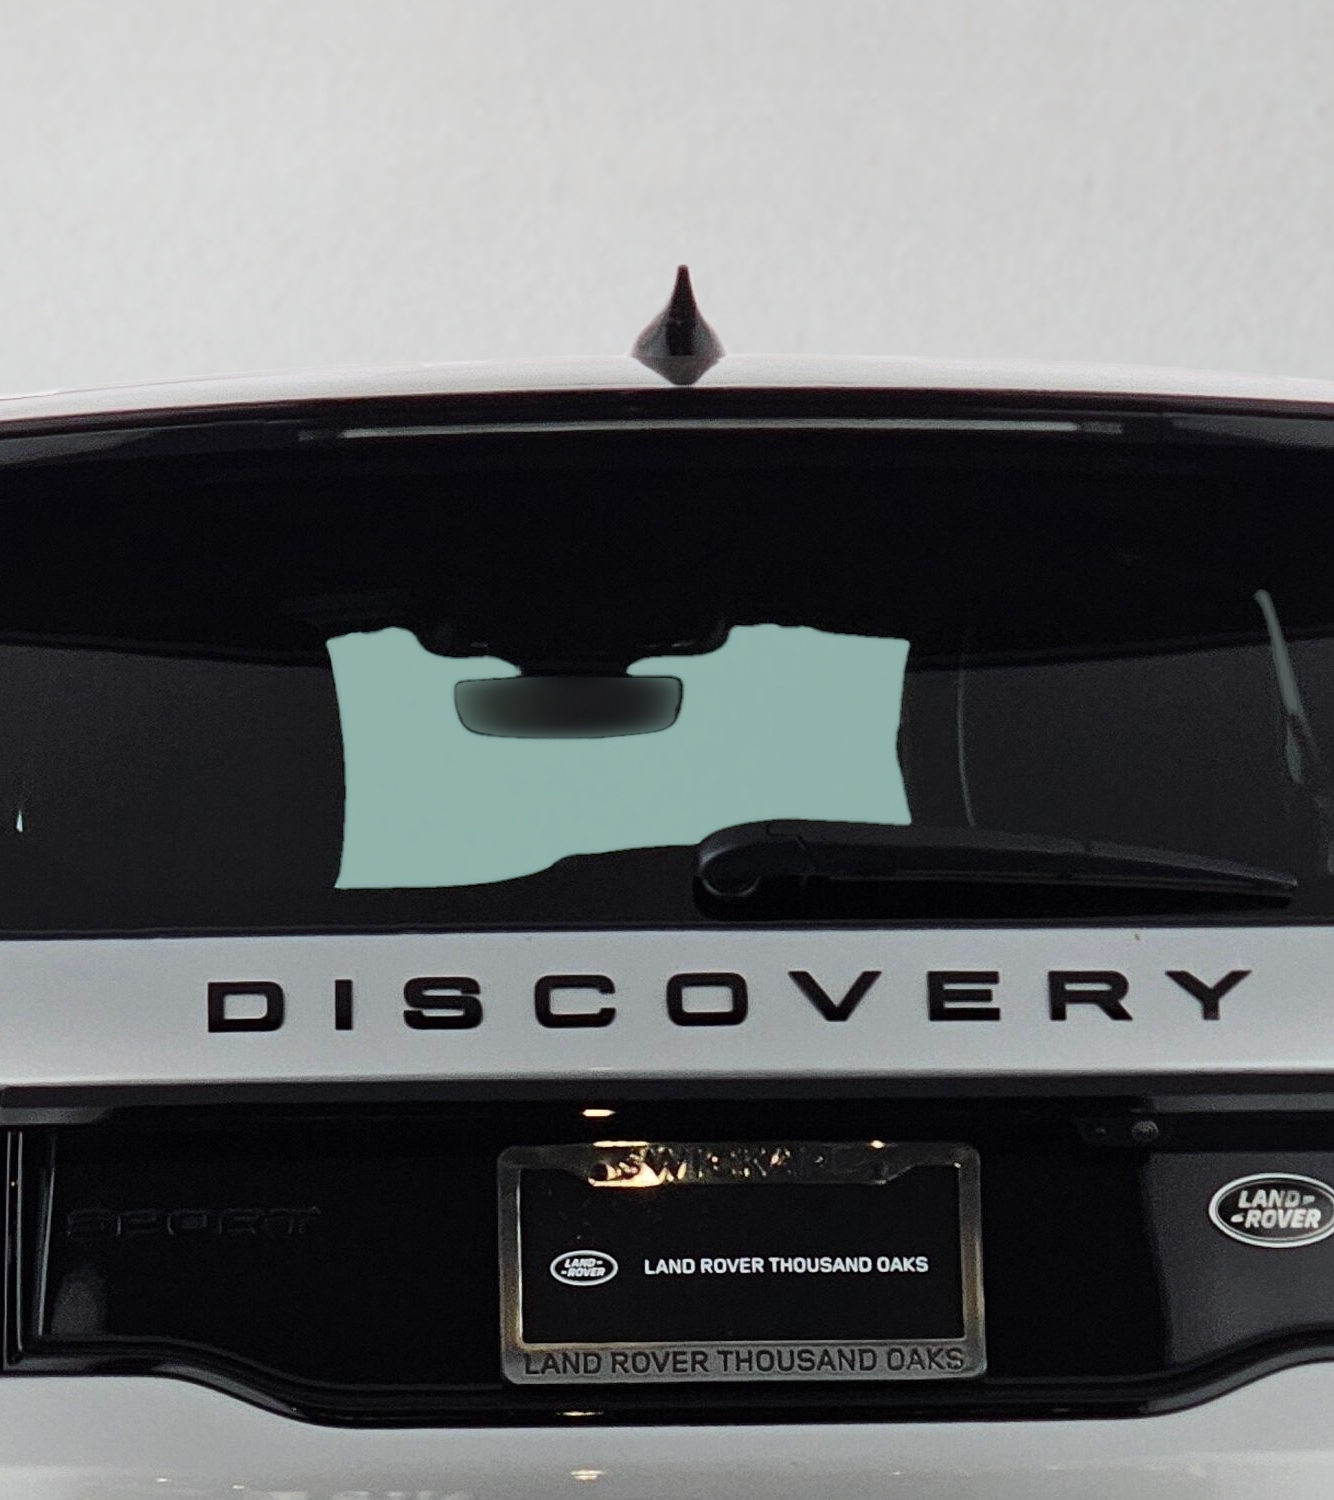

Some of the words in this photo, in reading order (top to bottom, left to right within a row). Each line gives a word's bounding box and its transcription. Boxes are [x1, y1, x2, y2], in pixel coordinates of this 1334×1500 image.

[207, 969, 1253, 1033] DISCOVERY
[644, 1258, 695, 1275] LAND
[700, 1257, 765, 1274] ROVER
[768, 1256, 873, 1273] THOUSAND
[877, 1256, 929, 1273] OAKS
[523, 1351, 602, 1375] LAND
[611, 1350, 709, 1374] ROVER
[718, 1348, 878, 1372] THOUSAND
[886, 1347, 964, 1371] OAKS
